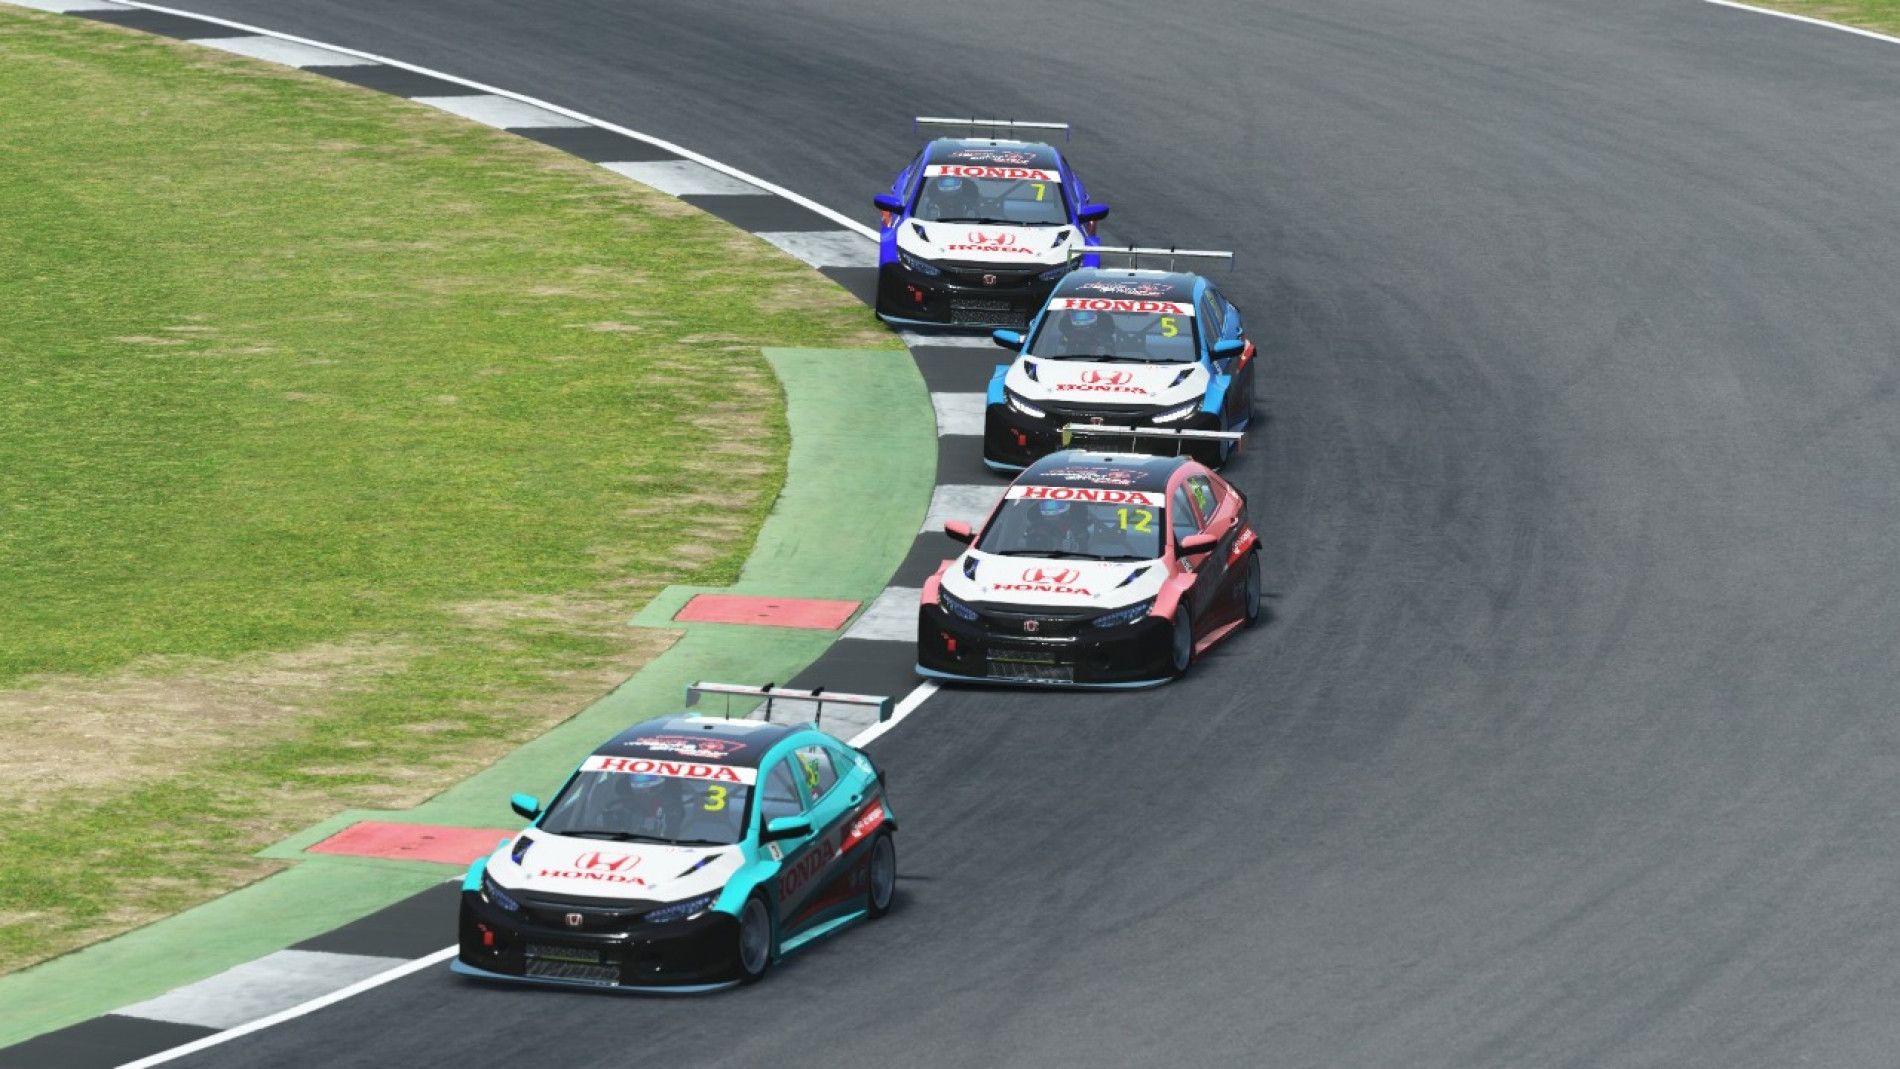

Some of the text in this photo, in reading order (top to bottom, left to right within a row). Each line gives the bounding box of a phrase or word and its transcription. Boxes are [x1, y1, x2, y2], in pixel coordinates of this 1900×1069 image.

[939, 165, 1050, 180] HONDA
[1031, 183, 1046, 201] 7
[948, 244, 1034, 255] HONDA
[1064, 298, 1185, 314] HONDA
[1159, 317, 1178, 337] 5
[1056, 384, 1148, 395] HONDA
[1023, 486, 1154, 506] HONDA
[1117, 508, 1153, 534] 12
[994, 583, 1092, 596] HONDA
[600, 757, 742, 783] HONDA
[704, 784, 727, 812] 3
[538, 868, 647, 887] HONDA
